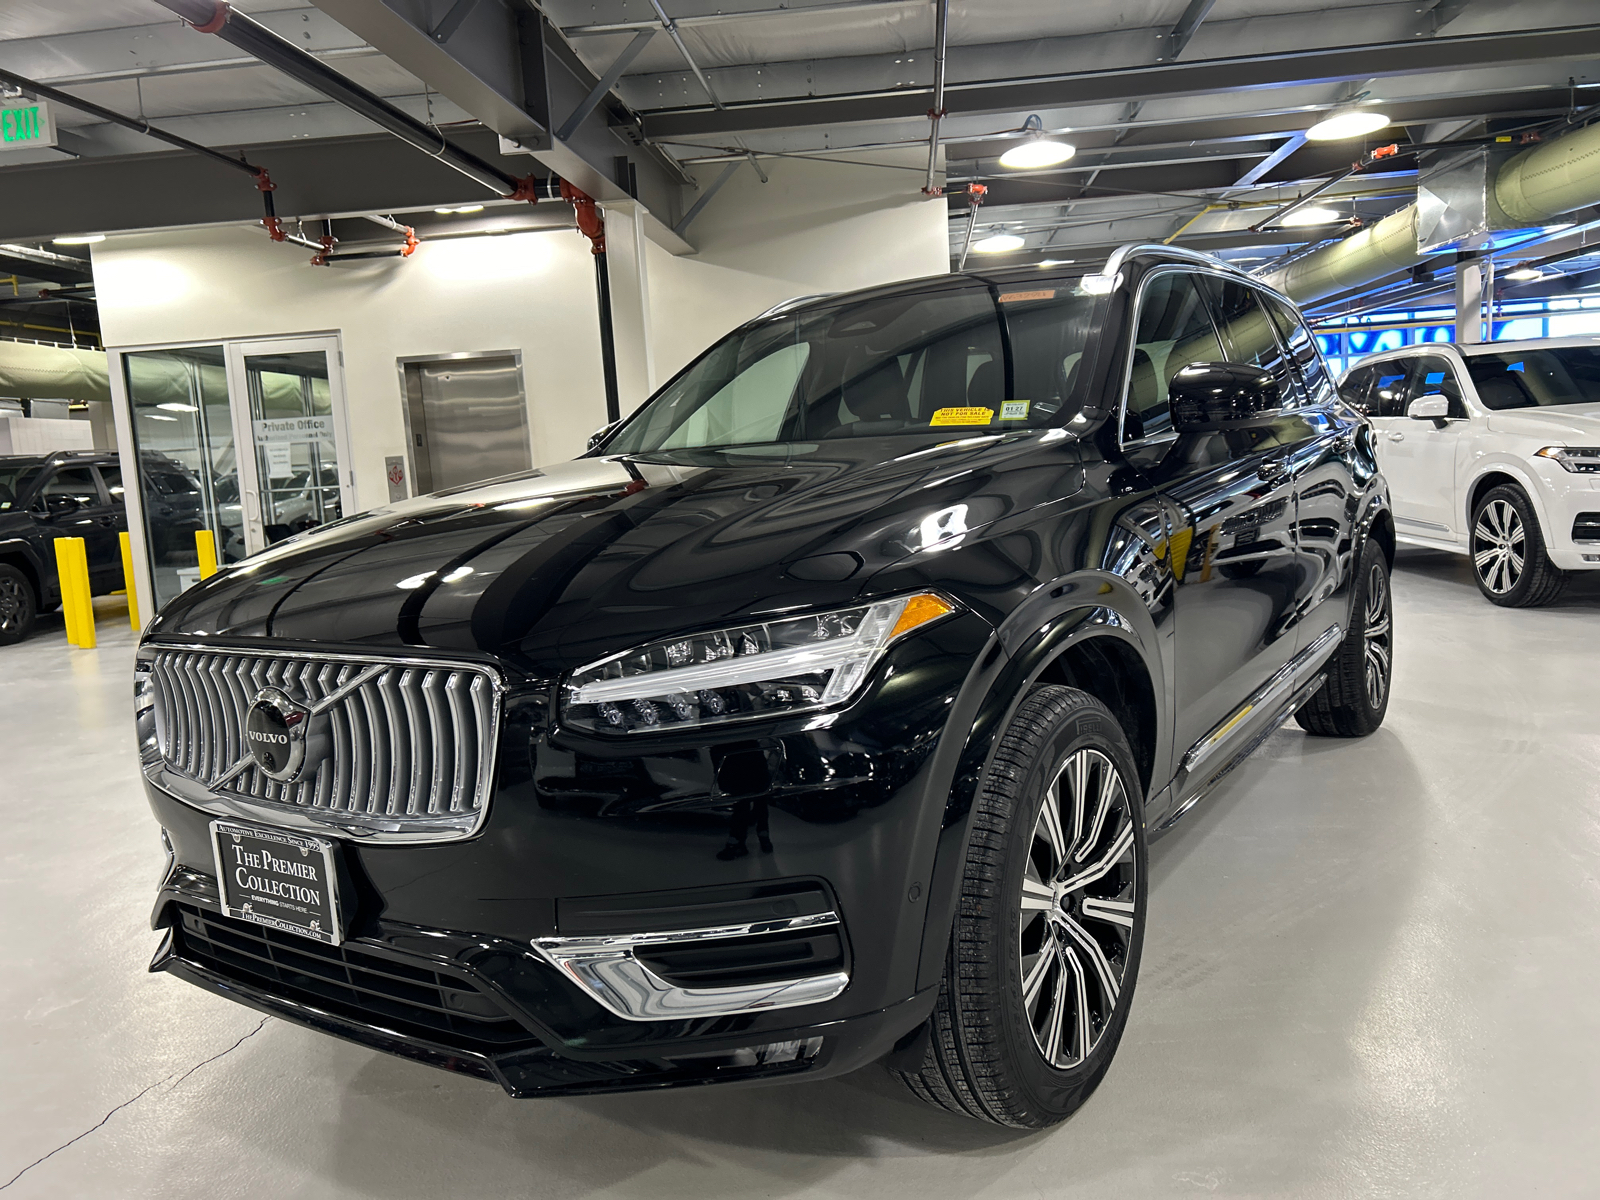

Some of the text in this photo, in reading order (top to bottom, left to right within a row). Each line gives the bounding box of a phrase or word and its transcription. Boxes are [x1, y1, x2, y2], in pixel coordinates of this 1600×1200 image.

[2, 106, 39, 142] EXIT
[262, 419, 325, 432] Private Office
[248, 730, 288, 745] VOLVO
[251, 894, 280, 906] EVERYTHING
[279, 901, 296, 910] STARTS
